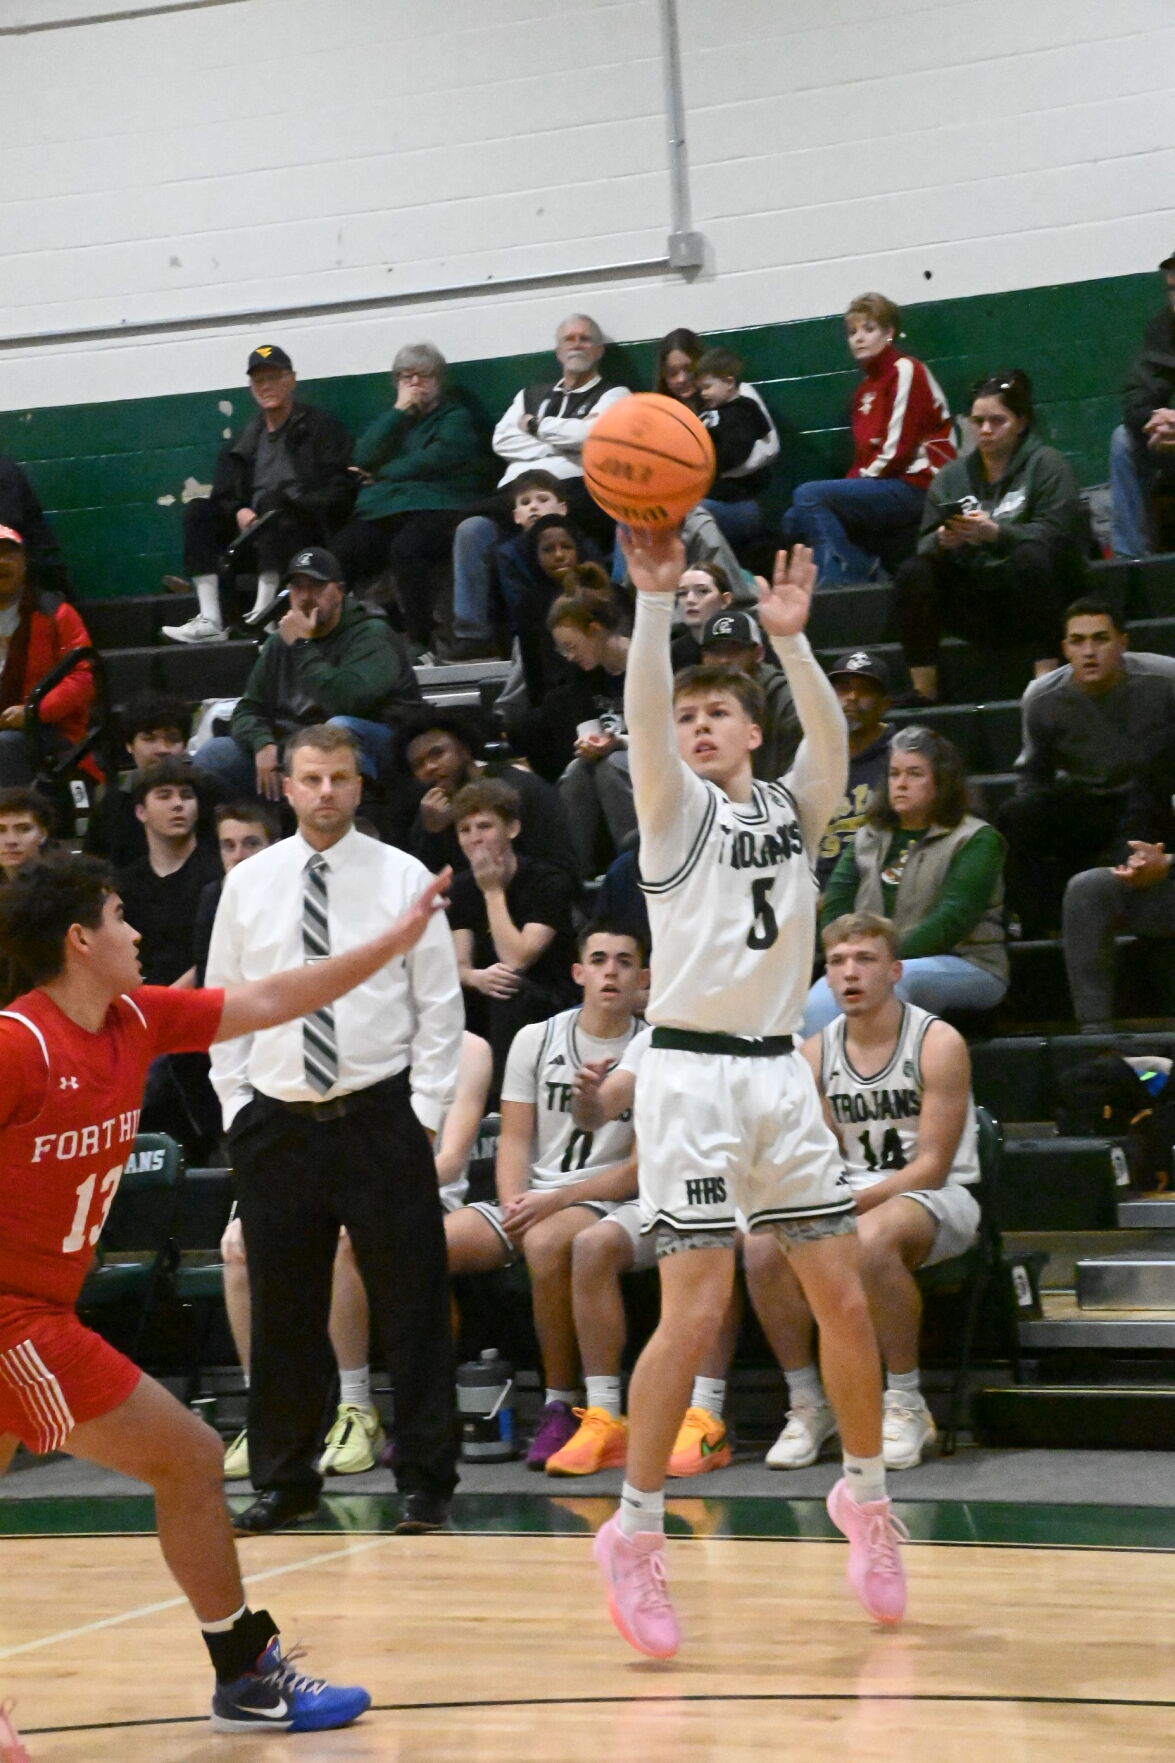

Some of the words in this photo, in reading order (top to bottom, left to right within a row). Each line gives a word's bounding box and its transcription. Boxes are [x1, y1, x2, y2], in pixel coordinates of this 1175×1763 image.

[829, 1089, 920, 1124] TROJANS
[31, 1118, 116, 1163] FORT
[858, 1128, 908, 1172] 14
[62, 1164, 124, 1253] 13
[685, 1176, 727, 1205] HHS
